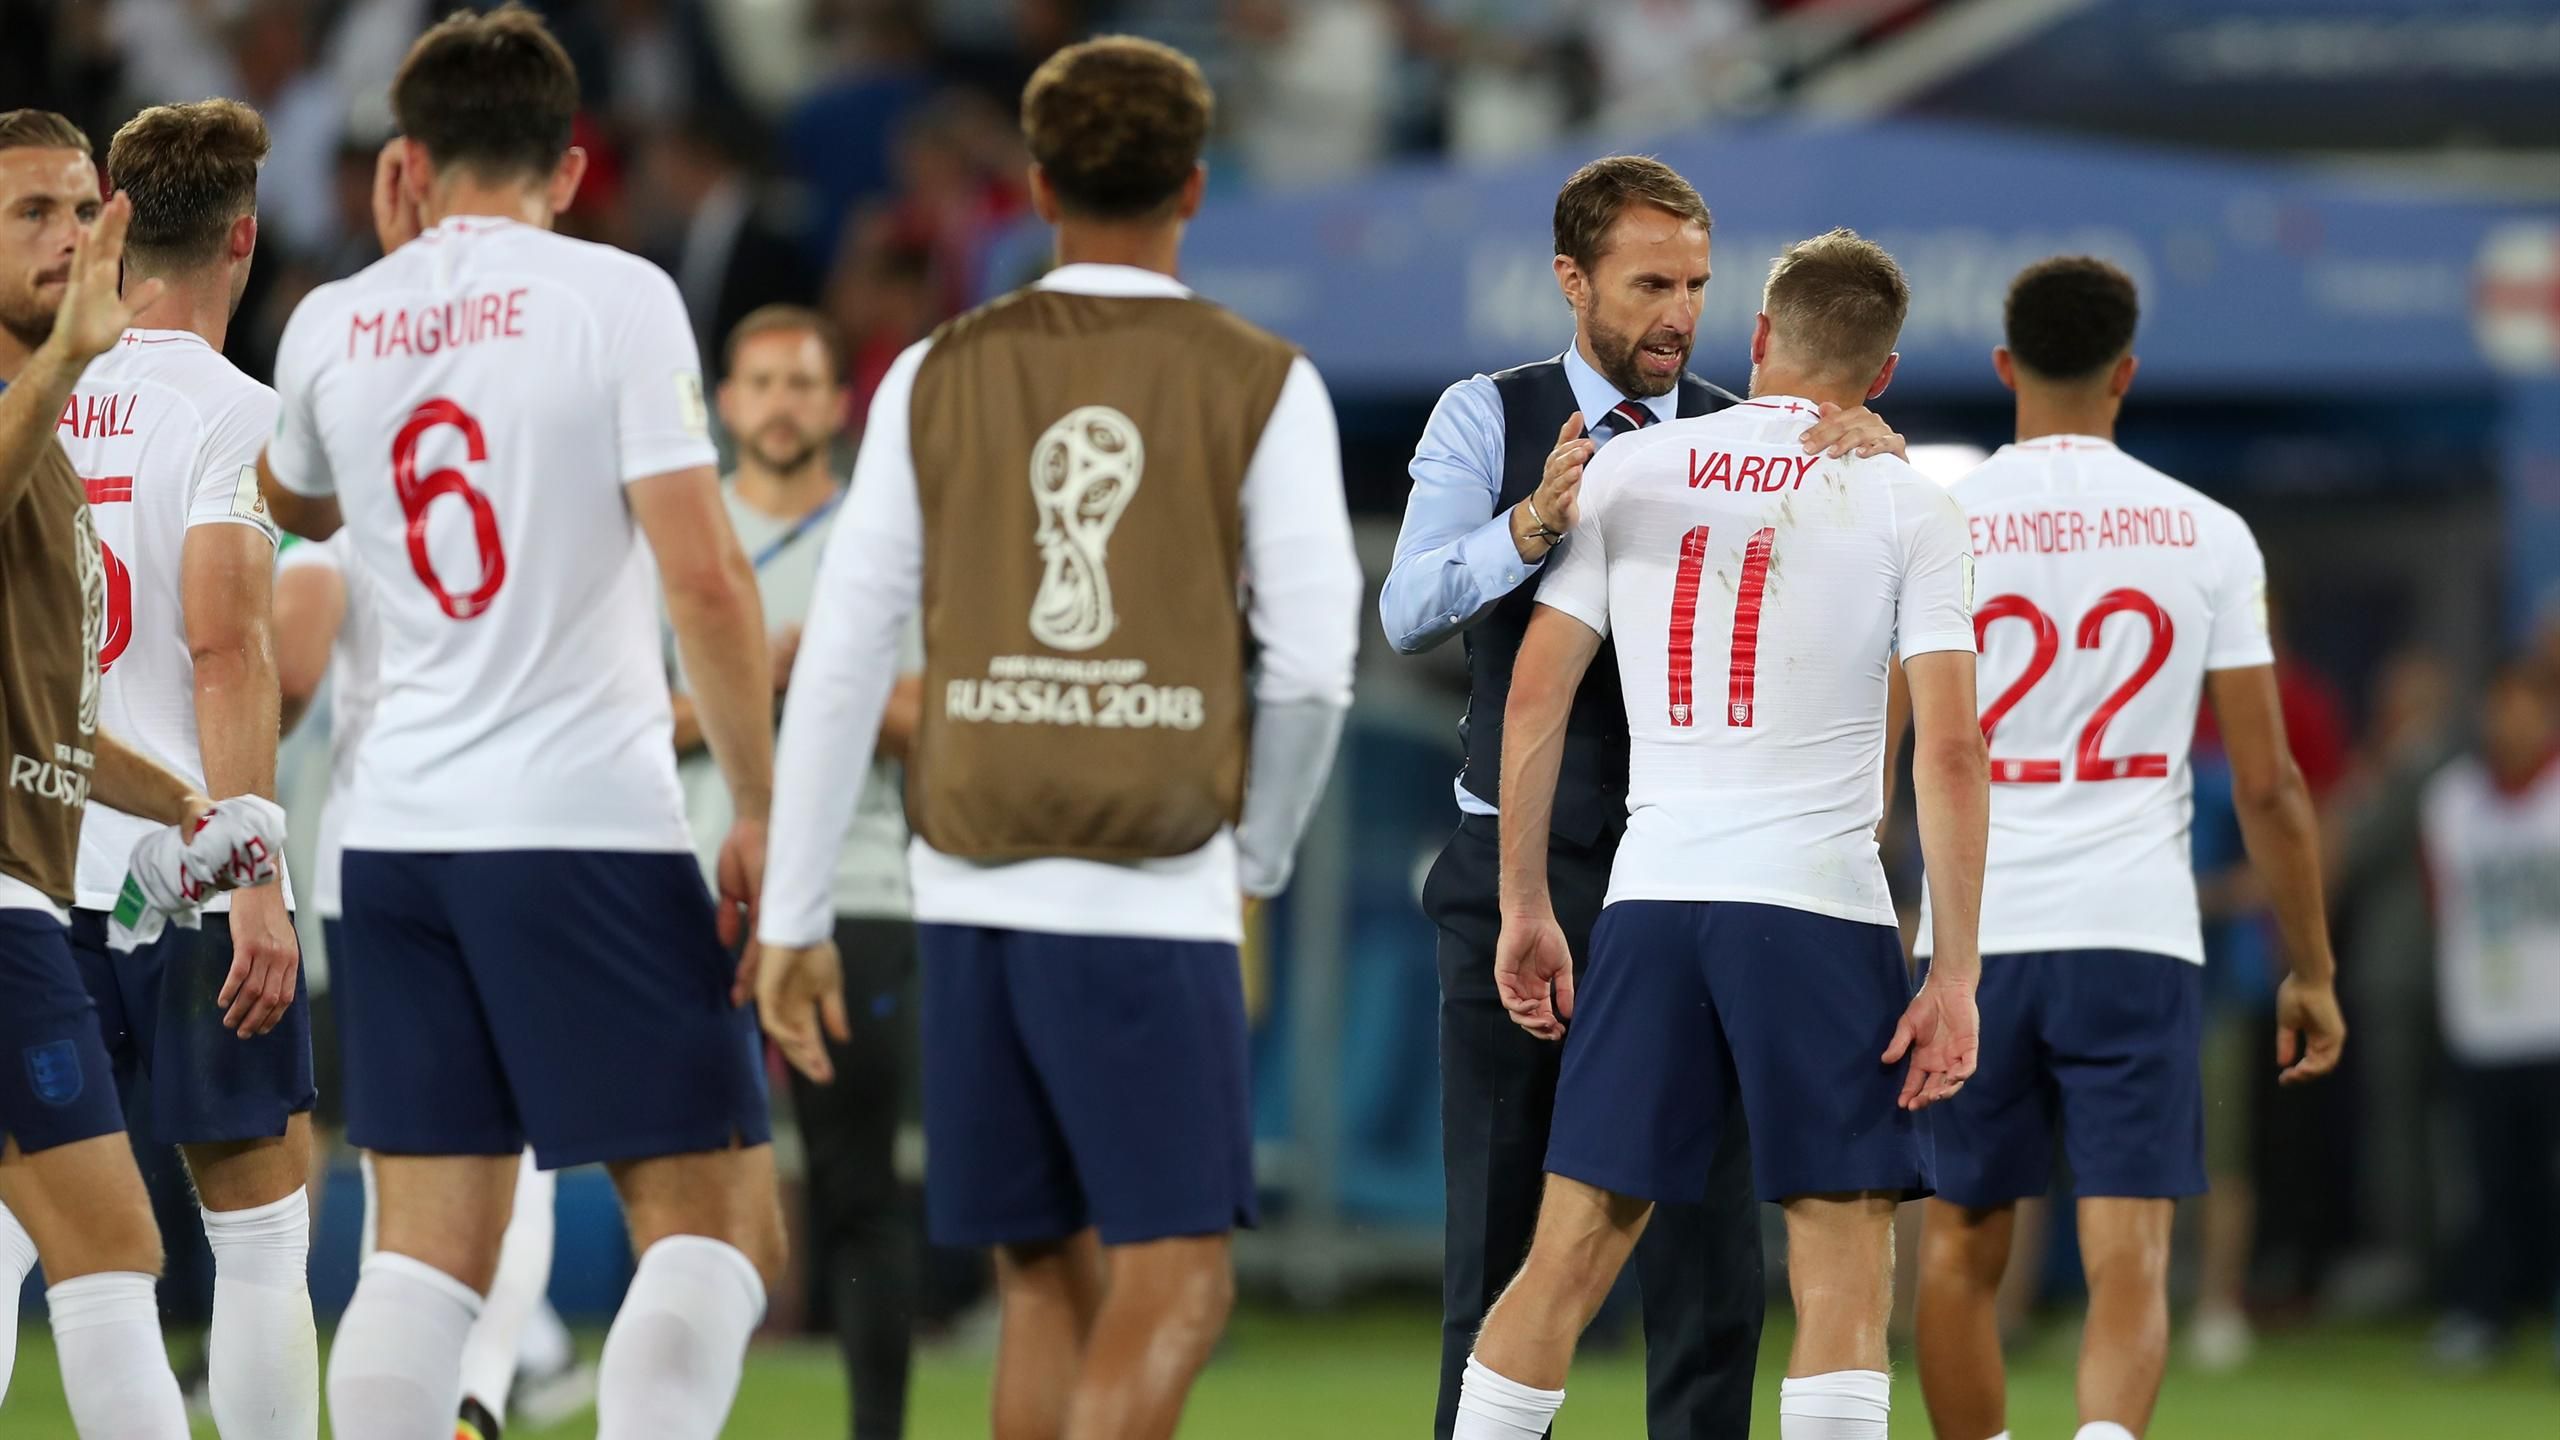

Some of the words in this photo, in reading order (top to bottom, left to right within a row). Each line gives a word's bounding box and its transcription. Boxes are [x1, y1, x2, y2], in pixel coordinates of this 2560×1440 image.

[349, 288, 528, 358] MAGUIRE
[54, 393, 137, 438] AHILL
[1688, 448, 1820, 492] VARDY
[391, 396, 506, 621] 6
[1968, 506, 2196, 556] EXANDER-ARNOLD
[1668, 525, 1776, 727] 11
[946, 679, 1094, 726] RUSSIA
[1096, 683, 1205, 730] 2018
[1973, 587, 2174, 783] 22
